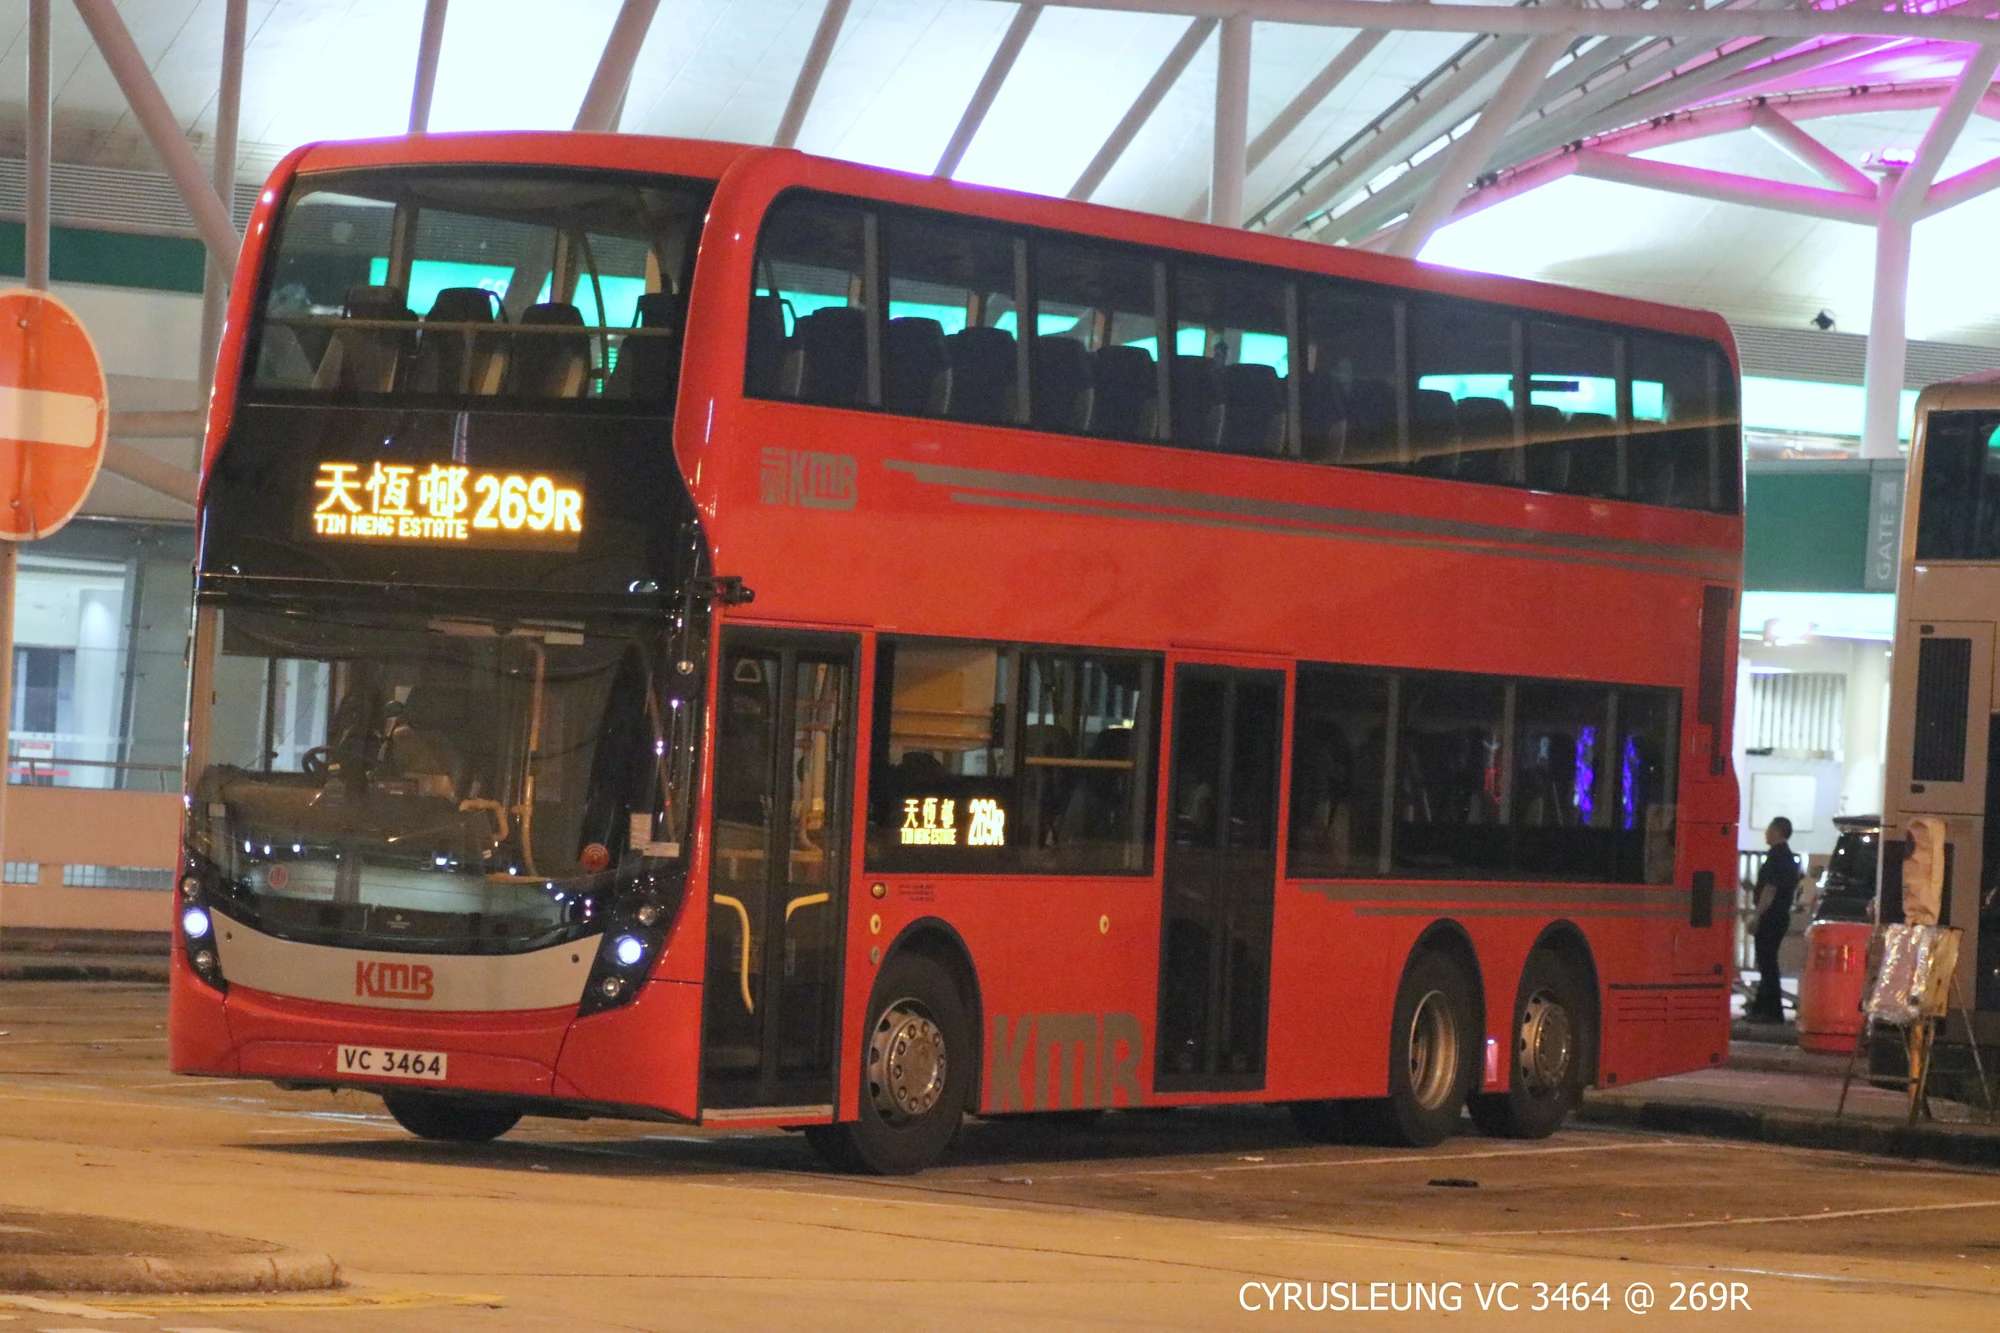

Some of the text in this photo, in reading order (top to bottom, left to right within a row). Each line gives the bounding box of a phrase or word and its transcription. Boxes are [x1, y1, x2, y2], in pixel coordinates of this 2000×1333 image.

[473, 475, 582, 532] 269R
[399, 517, 469, 539] ESTATE
[1876, 512, 1894, 580] GATE
[356, 960, 435, 1001] KMB
[344, 1048, 441, 1076] VC 3464
